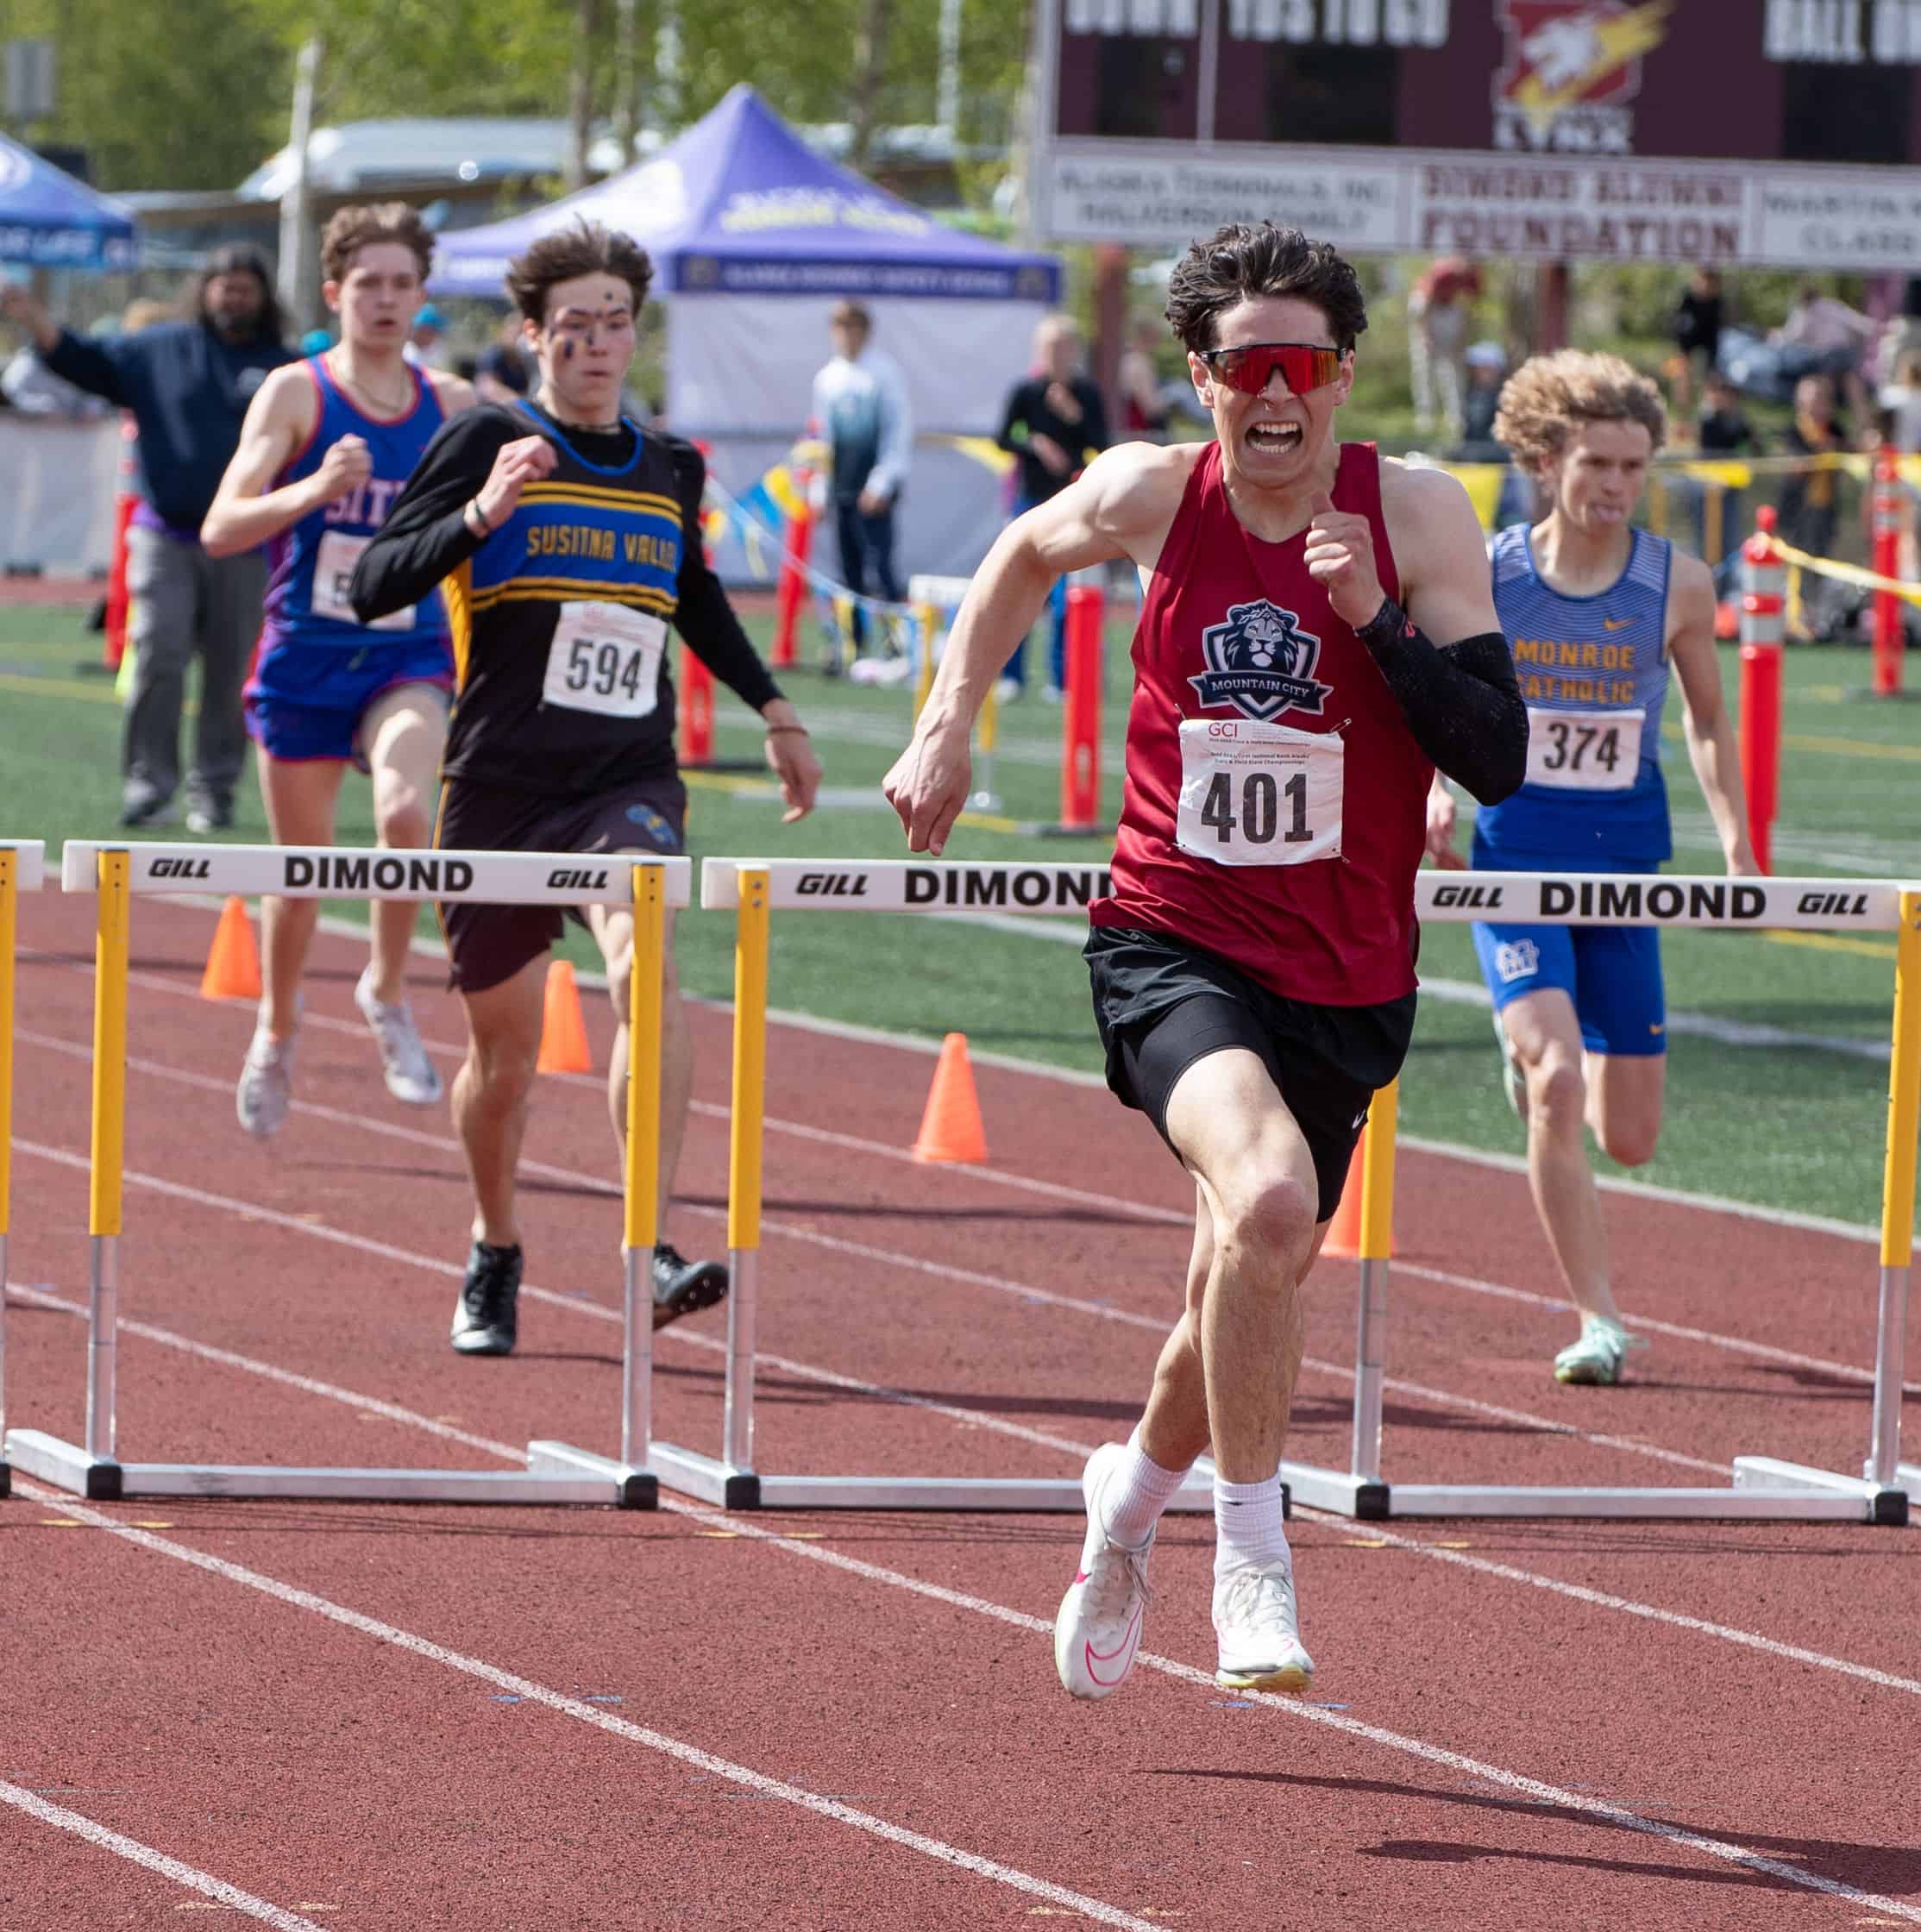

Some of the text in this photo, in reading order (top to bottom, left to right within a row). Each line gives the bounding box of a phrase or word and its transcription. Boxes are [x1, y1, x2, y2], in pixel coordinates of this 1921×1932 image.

[1422, 210, 1741, 257] FOUNDATION
[525, 524, 617, 561] SUSITNA
[566, 638, 642, 700] 594
[1514, 637, 1636, 671] MONROE
[1211, 678, 1309, 698] MOUNTAIN CITY
[1208, 722, 1239, 738] GCI
[1543, 721, 1620, 773] 374
[1201, 772, 1314, 844] 401
[148, 856, 609, 892] GILL DIMOND GILL
[795, 873, 869, 897] GILL
[1432, 880, 1868, 919] GILL DIMOND GILL
